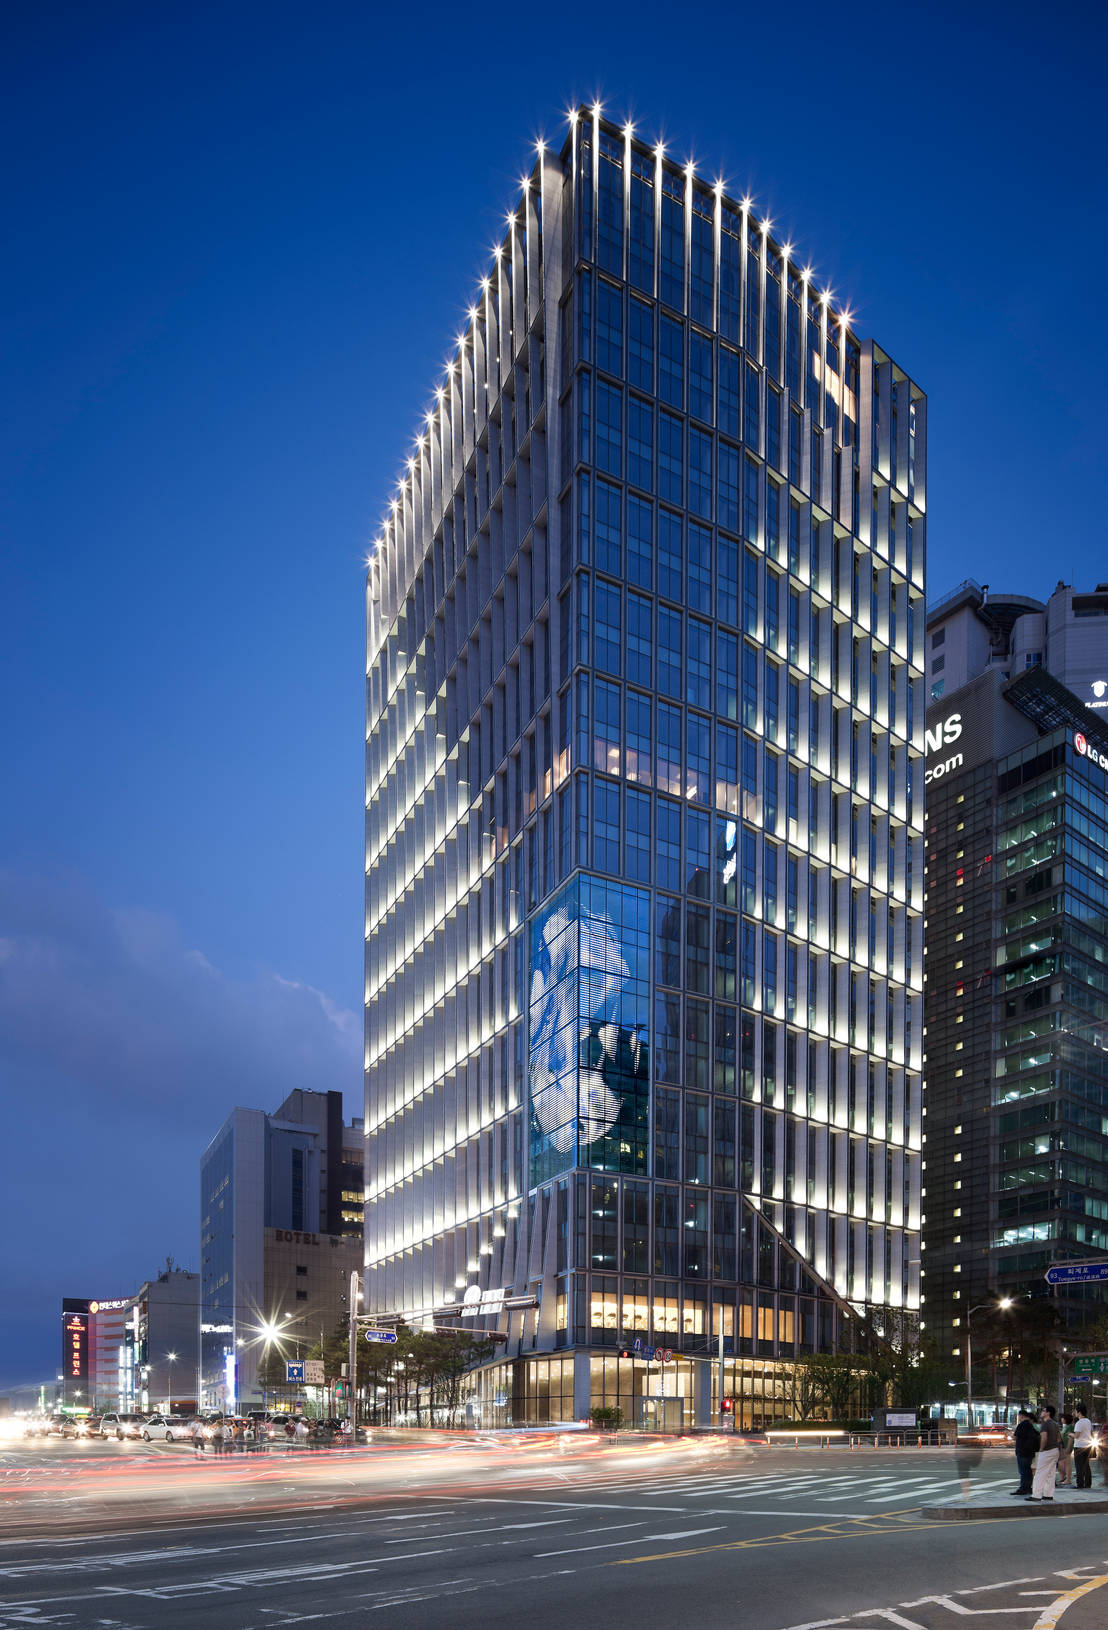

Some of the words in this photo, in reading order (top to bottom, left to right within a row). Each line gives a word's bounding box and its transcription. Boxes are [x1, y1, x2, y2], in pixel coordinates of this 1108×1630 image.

[924, 713, 963, 757] NS
[1087, 744, 1098, 763] LG
[275, 1229, 320, 1246] HOTEL
